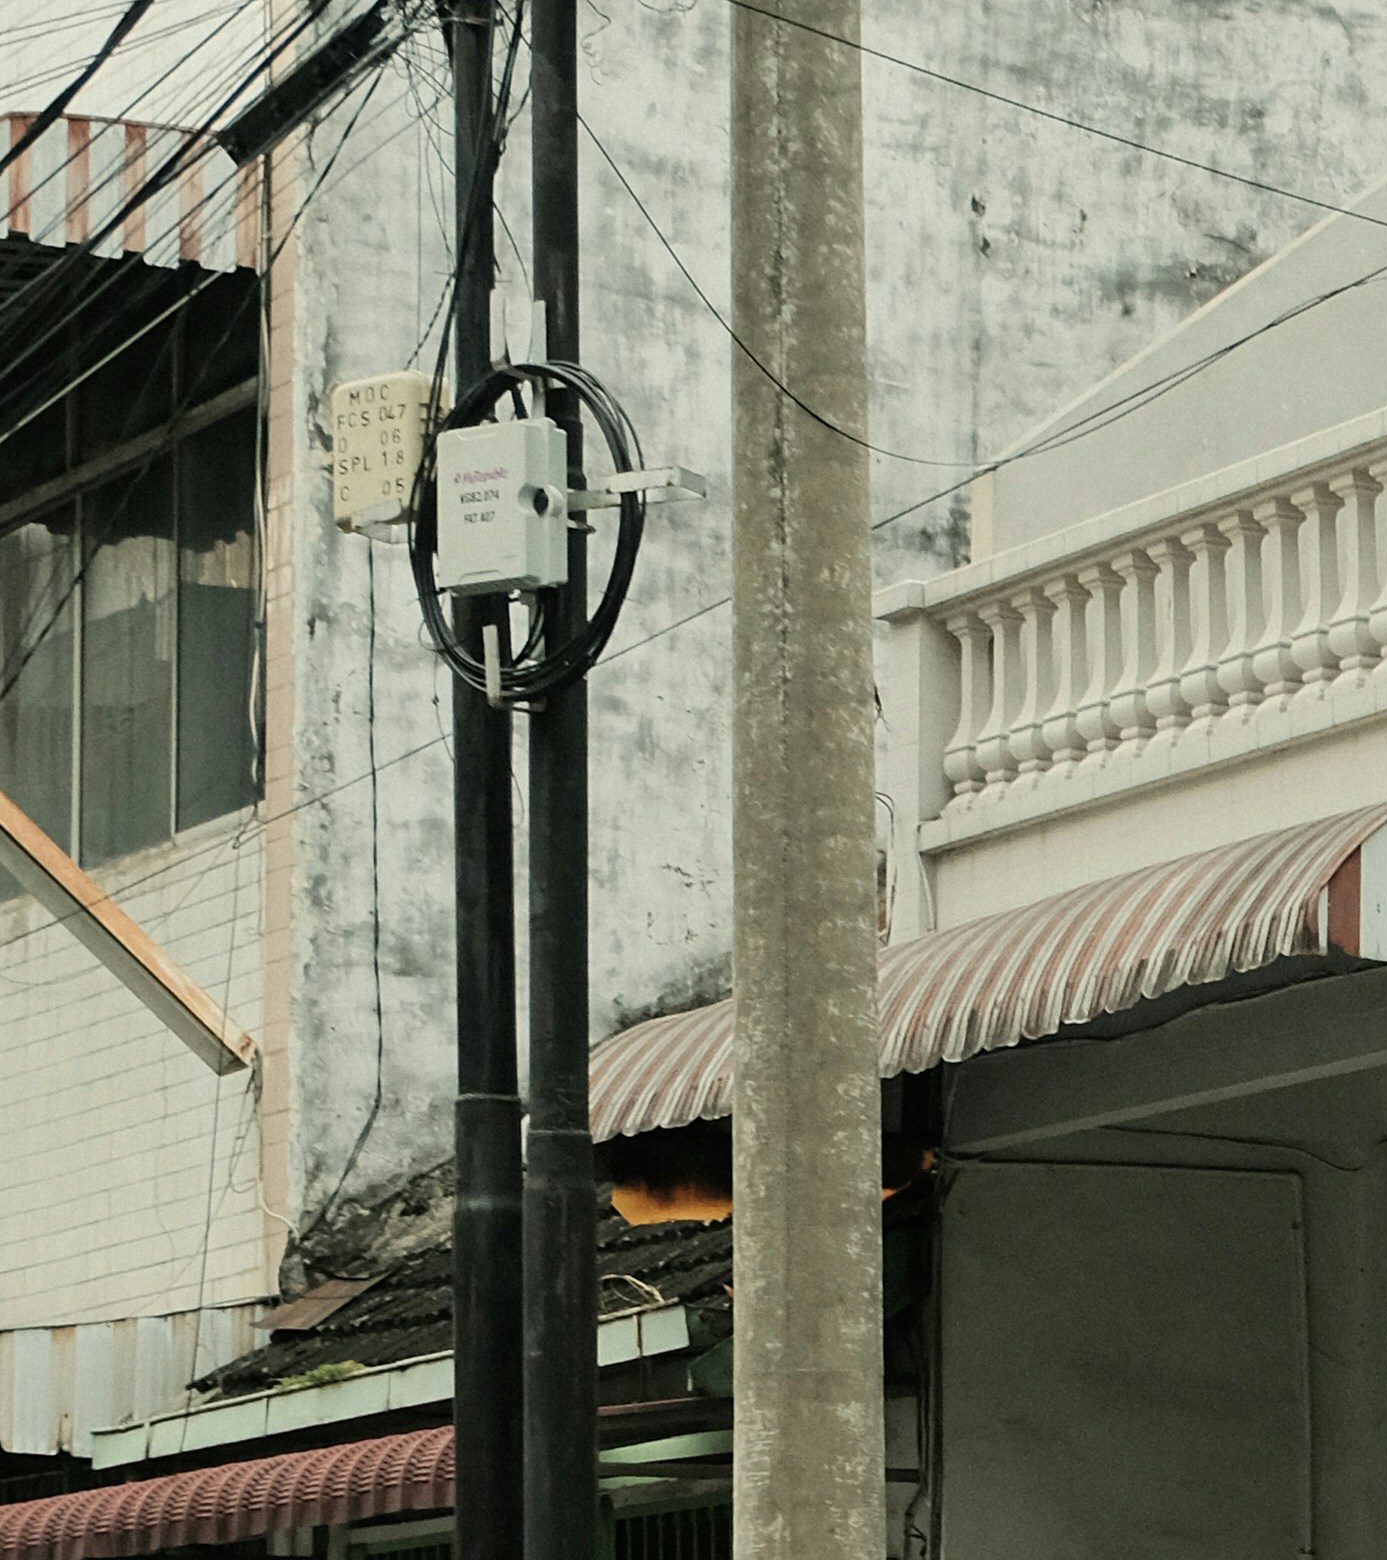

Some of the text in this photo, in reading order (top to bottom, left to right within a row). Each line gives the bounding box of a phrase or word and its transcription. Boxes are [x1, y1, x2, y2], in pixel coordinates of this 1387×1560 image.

[337, 410, 370, 431] FCS
[339, 455, 371, 476] SPL
[340, 485, 350, 502] C
